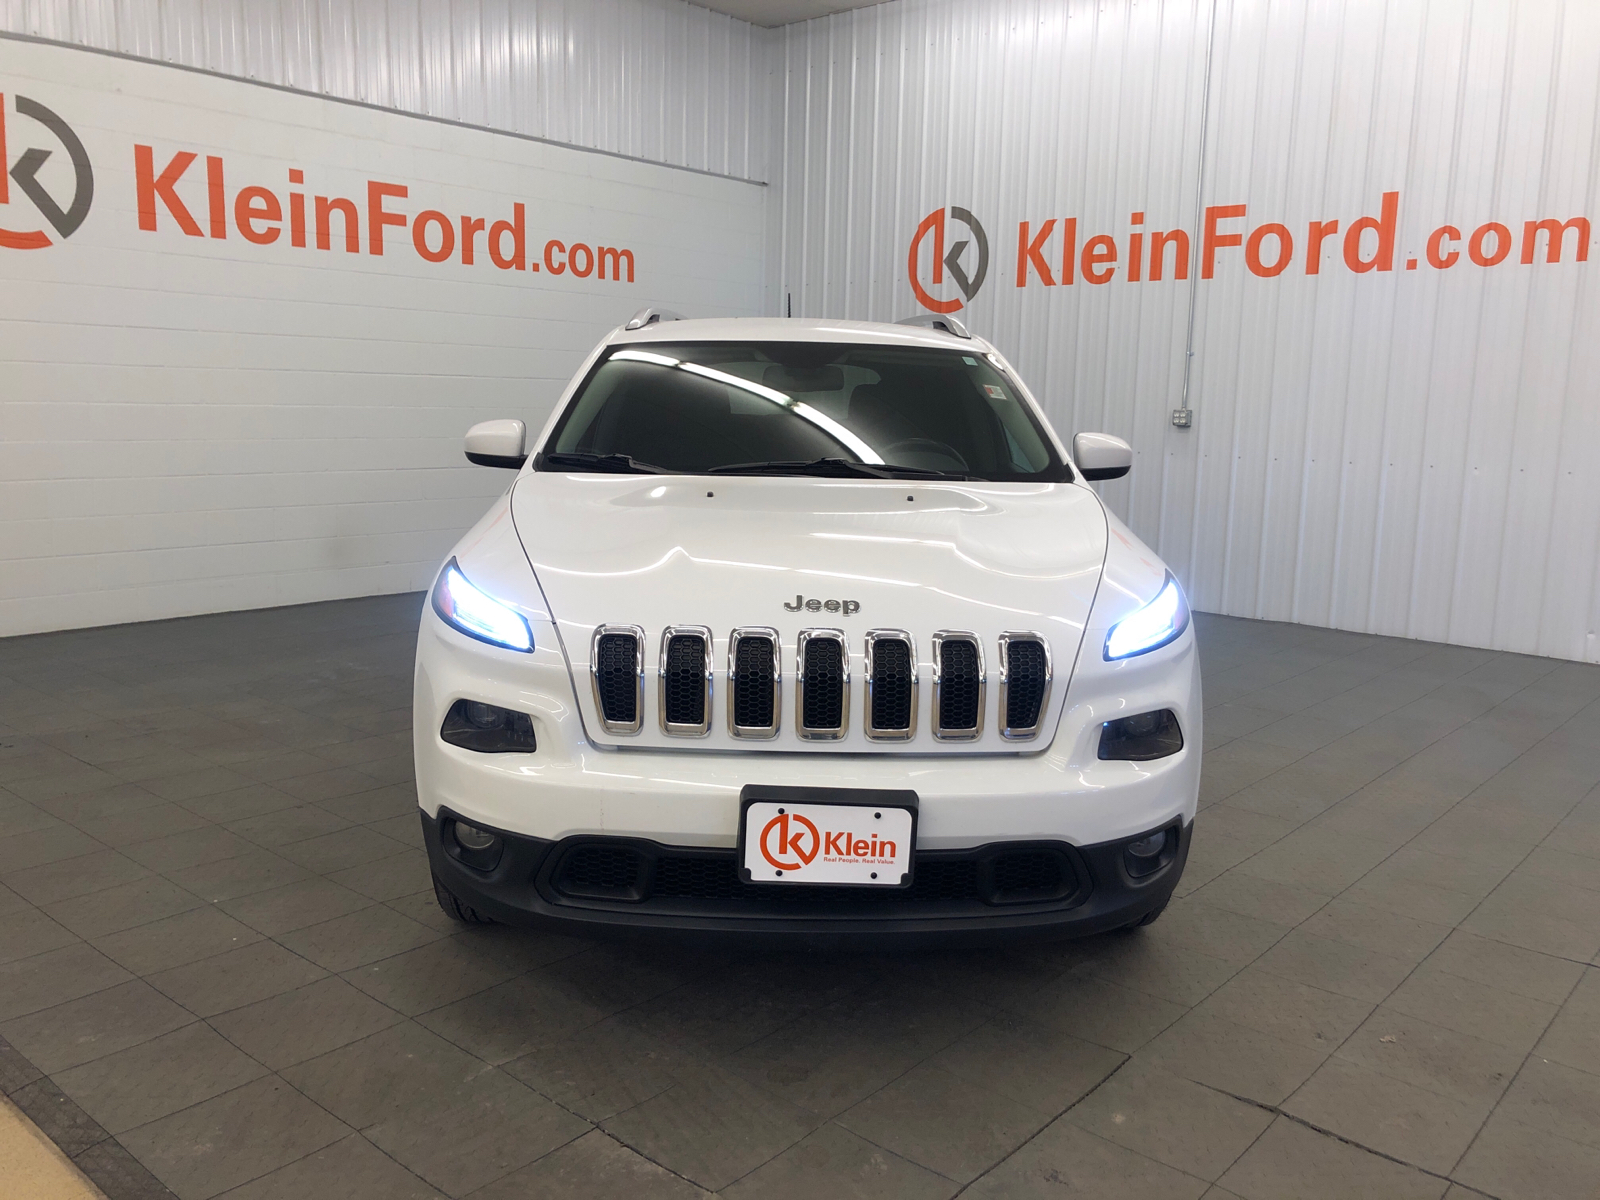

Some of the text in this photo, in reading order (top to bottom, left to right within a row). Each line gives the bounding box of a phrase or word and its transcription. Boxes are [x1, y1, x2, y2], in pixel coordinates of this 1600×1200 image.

[134, 143, 636, 283] KleinFord.com
[1016, 191, 1590, 288] KleinFord.com
[783, 594, 861, 617] Jeep
[824, 831, 897, 858] Klein
